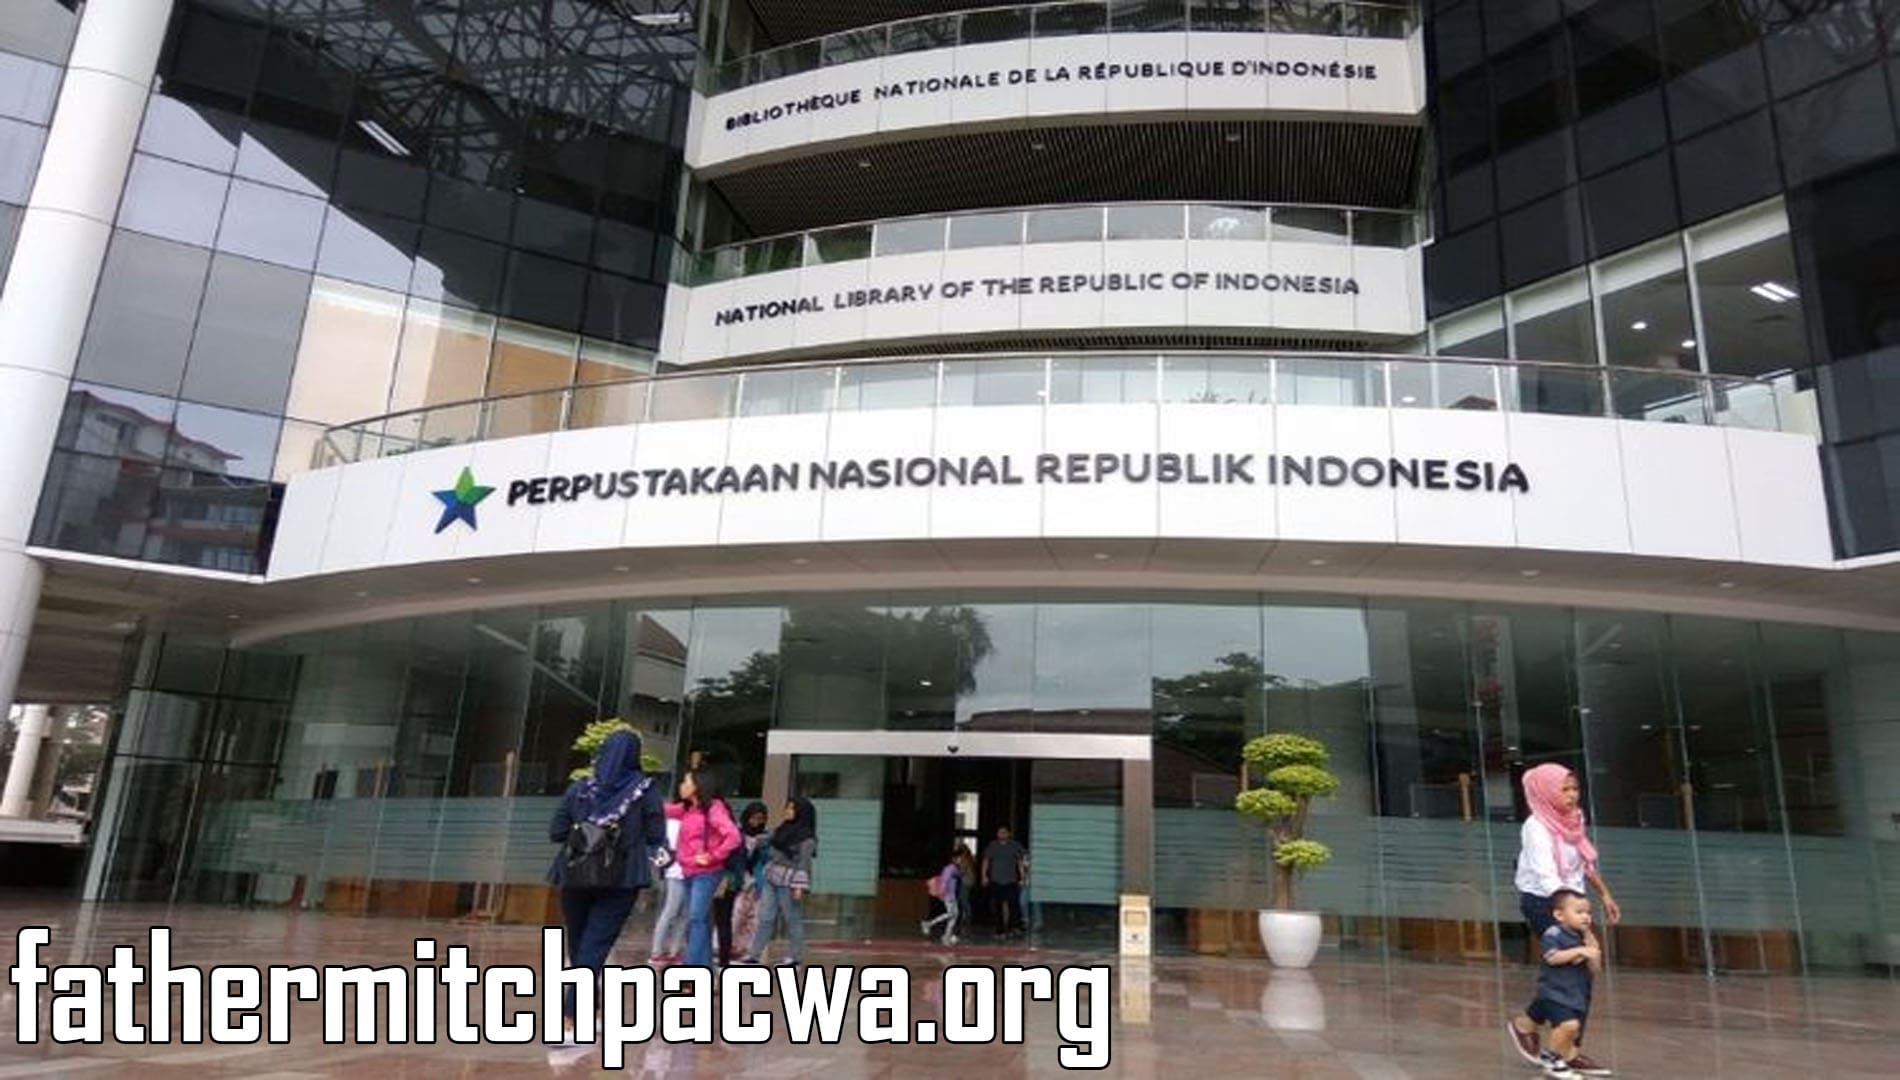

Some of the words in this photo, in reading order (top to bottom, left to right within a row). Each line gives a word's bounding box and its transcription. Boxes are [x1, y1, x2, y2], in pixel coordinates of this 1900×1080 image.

[874, 72, 999, 99] NATIONALE
[1008, 68, 1037, 84] DE
[1044, 66, 1070, 81] LA
[1078, 61, 1224, 80] RÉPUBLIQUE
[1231, 60, 1377, 80] D'INDONÉSIE
[714, 295, 824, 327] NATIONAL
[833, 283, 934, 310] LIBRARY
[940, 279, 974, 300] OF
[981, 277, 1033, 298] THE
[1039, 272, 1164, 294] REPUBLIC
[1171, 271, 1209, 290] OF
[1215, 272, 1360, 295] INDONESIA
[506, 462, 800, 507] PERPUSTAKAAN
[809, 455, 1024, 489] NASIONAL
[1035, 452, 1255, 485] REPUBLIK
[1267, 454, 1531, 494] INDONESIA
